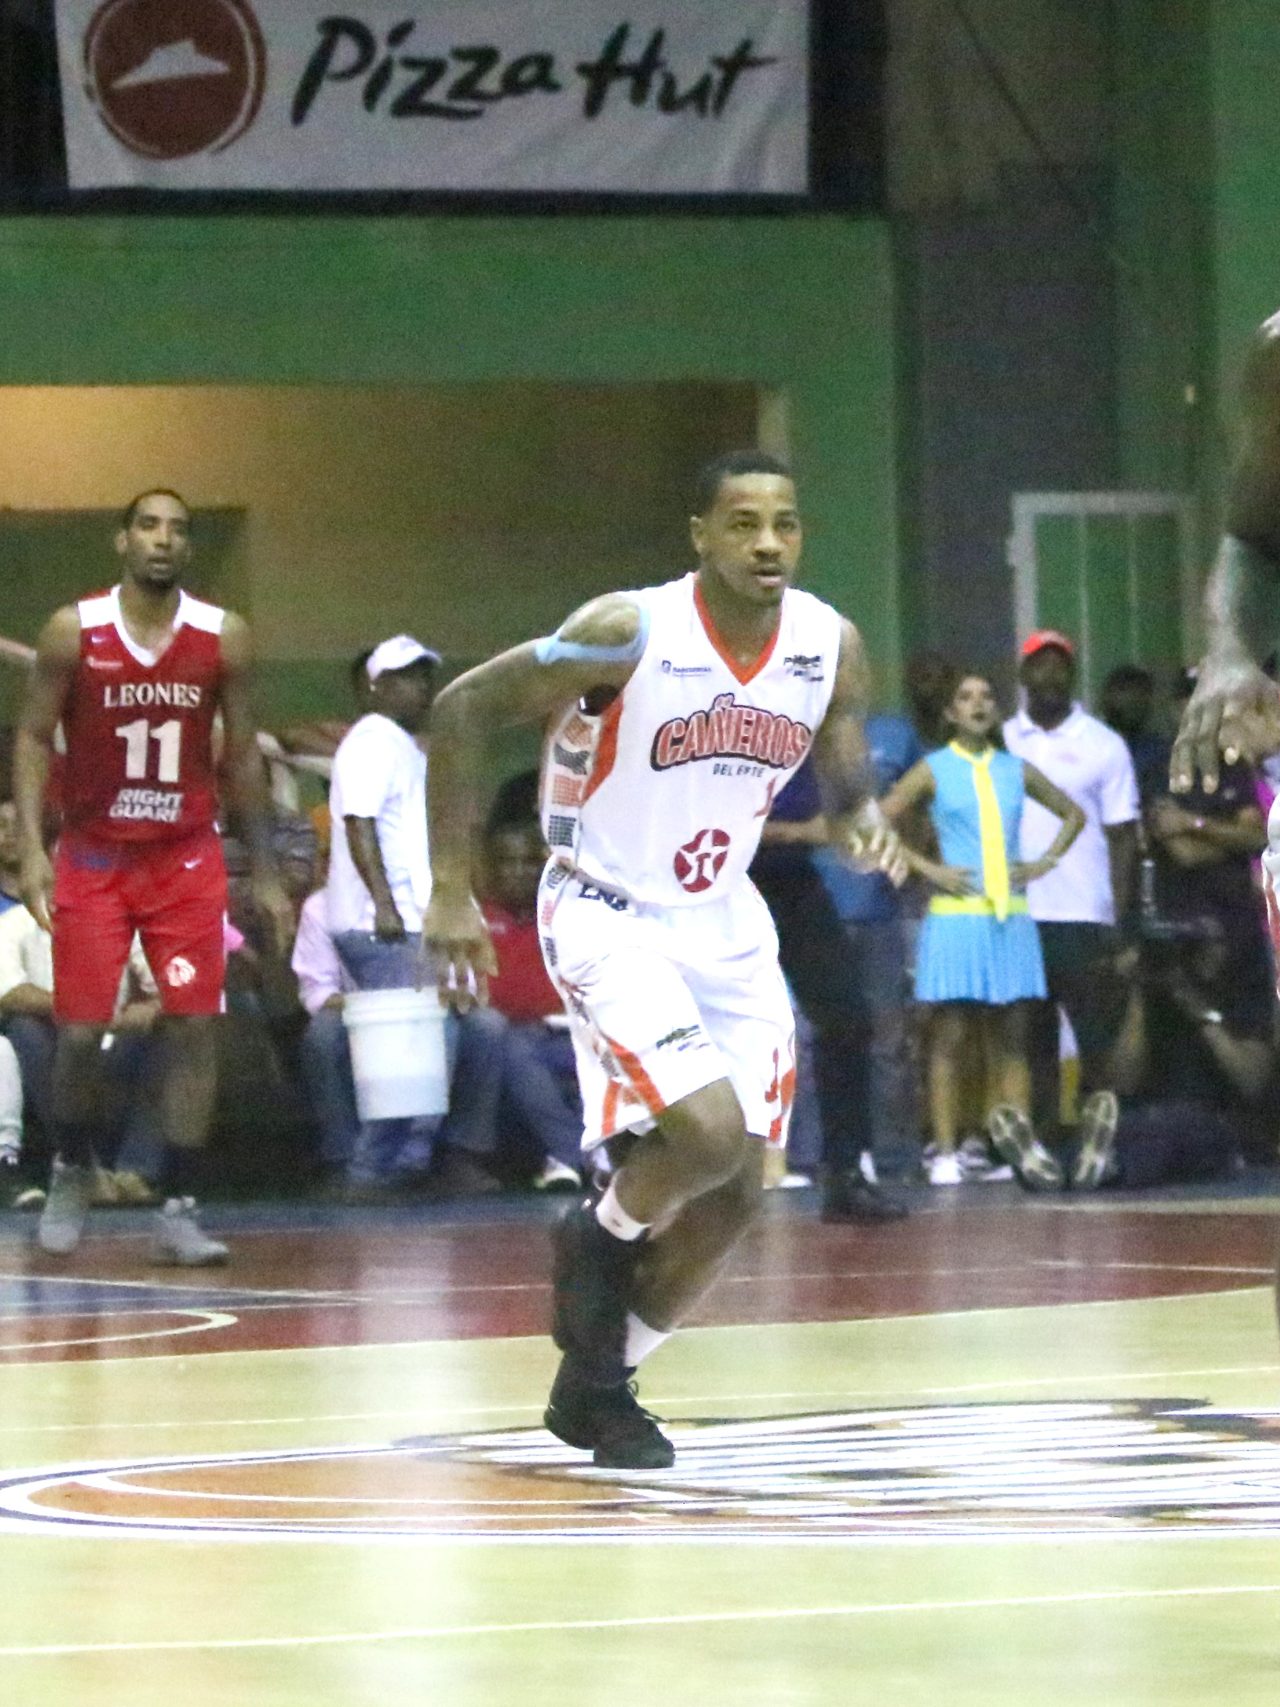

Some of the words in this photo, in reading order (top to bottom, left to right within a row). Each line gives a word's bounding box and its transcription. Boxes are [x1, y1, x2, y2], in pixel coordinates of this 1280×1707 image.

[291, 15, 562, 126] Pizza
[575, 21, 777, 119] Hut
[103, 682, 201, 708] LEONES
[115, 718, 181, 782] 11
[650, 692, 811, 771] CAÑEROS
[712, 763, 733, 776] DEL
[116, 788, 184, 809] RIGHT
